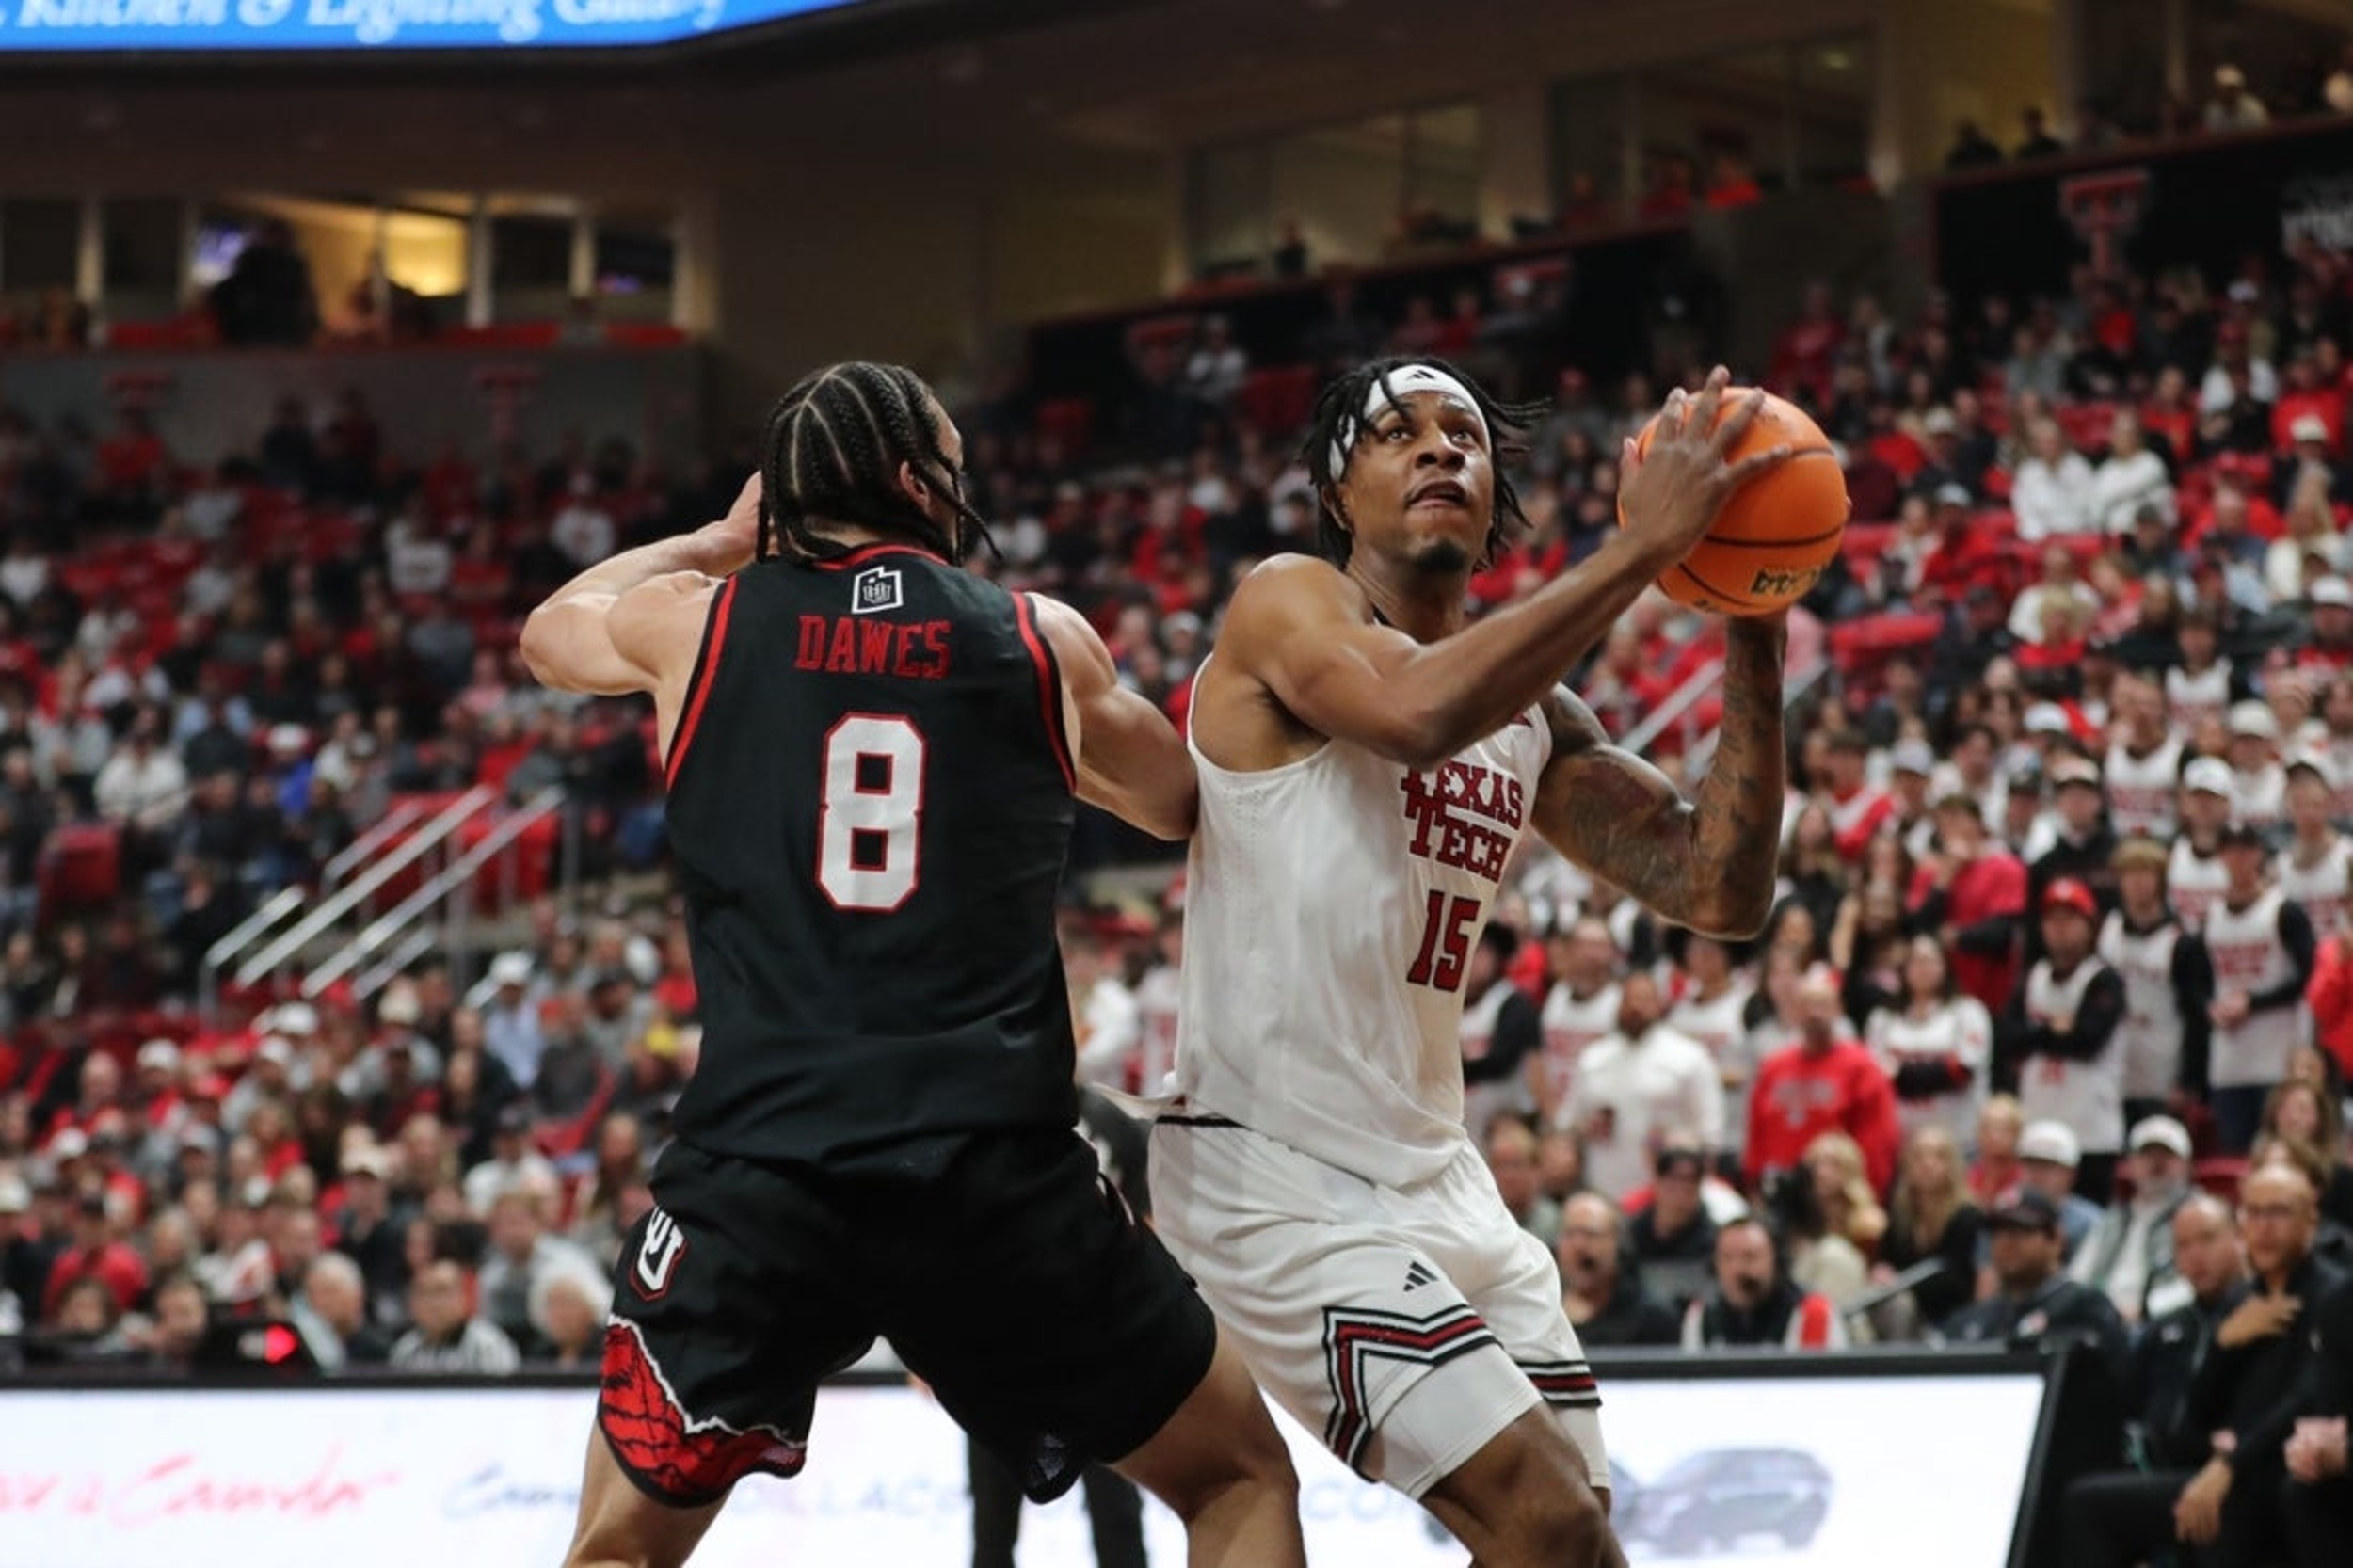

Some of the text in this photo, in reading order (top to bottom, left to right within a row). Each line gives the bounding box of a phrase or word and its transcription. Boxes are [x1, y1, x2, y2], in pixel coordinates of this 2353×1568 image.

[794, 615, 952, 680] DAWES
[814, 712, 927, 913] 8
[1405, 793, 1513, 883] TECH
[1406, 888, 1481, 994] 15
